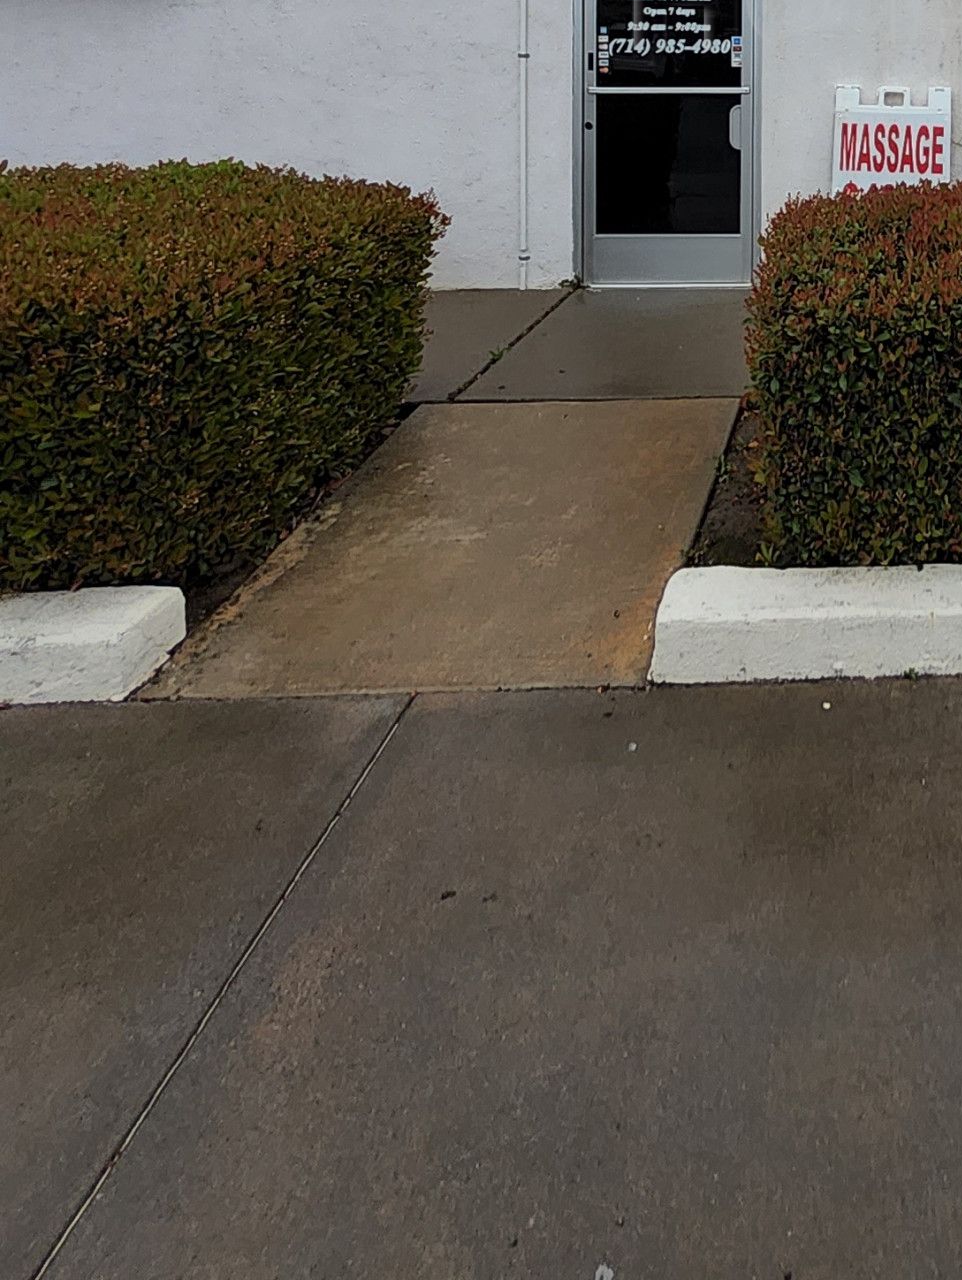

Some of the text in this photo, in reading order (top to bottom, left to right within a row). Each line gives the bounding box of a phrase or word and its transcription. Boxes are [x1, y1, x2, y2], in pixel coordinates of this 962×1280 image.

[643, 7, 696, 17] Open 7 days
[650, 23, 667, 31] am
[608, 38, 651, 57] (714)
[655, 38, 731, 55] 985-4980
[839, 122, 945, 175] MASSAGE
